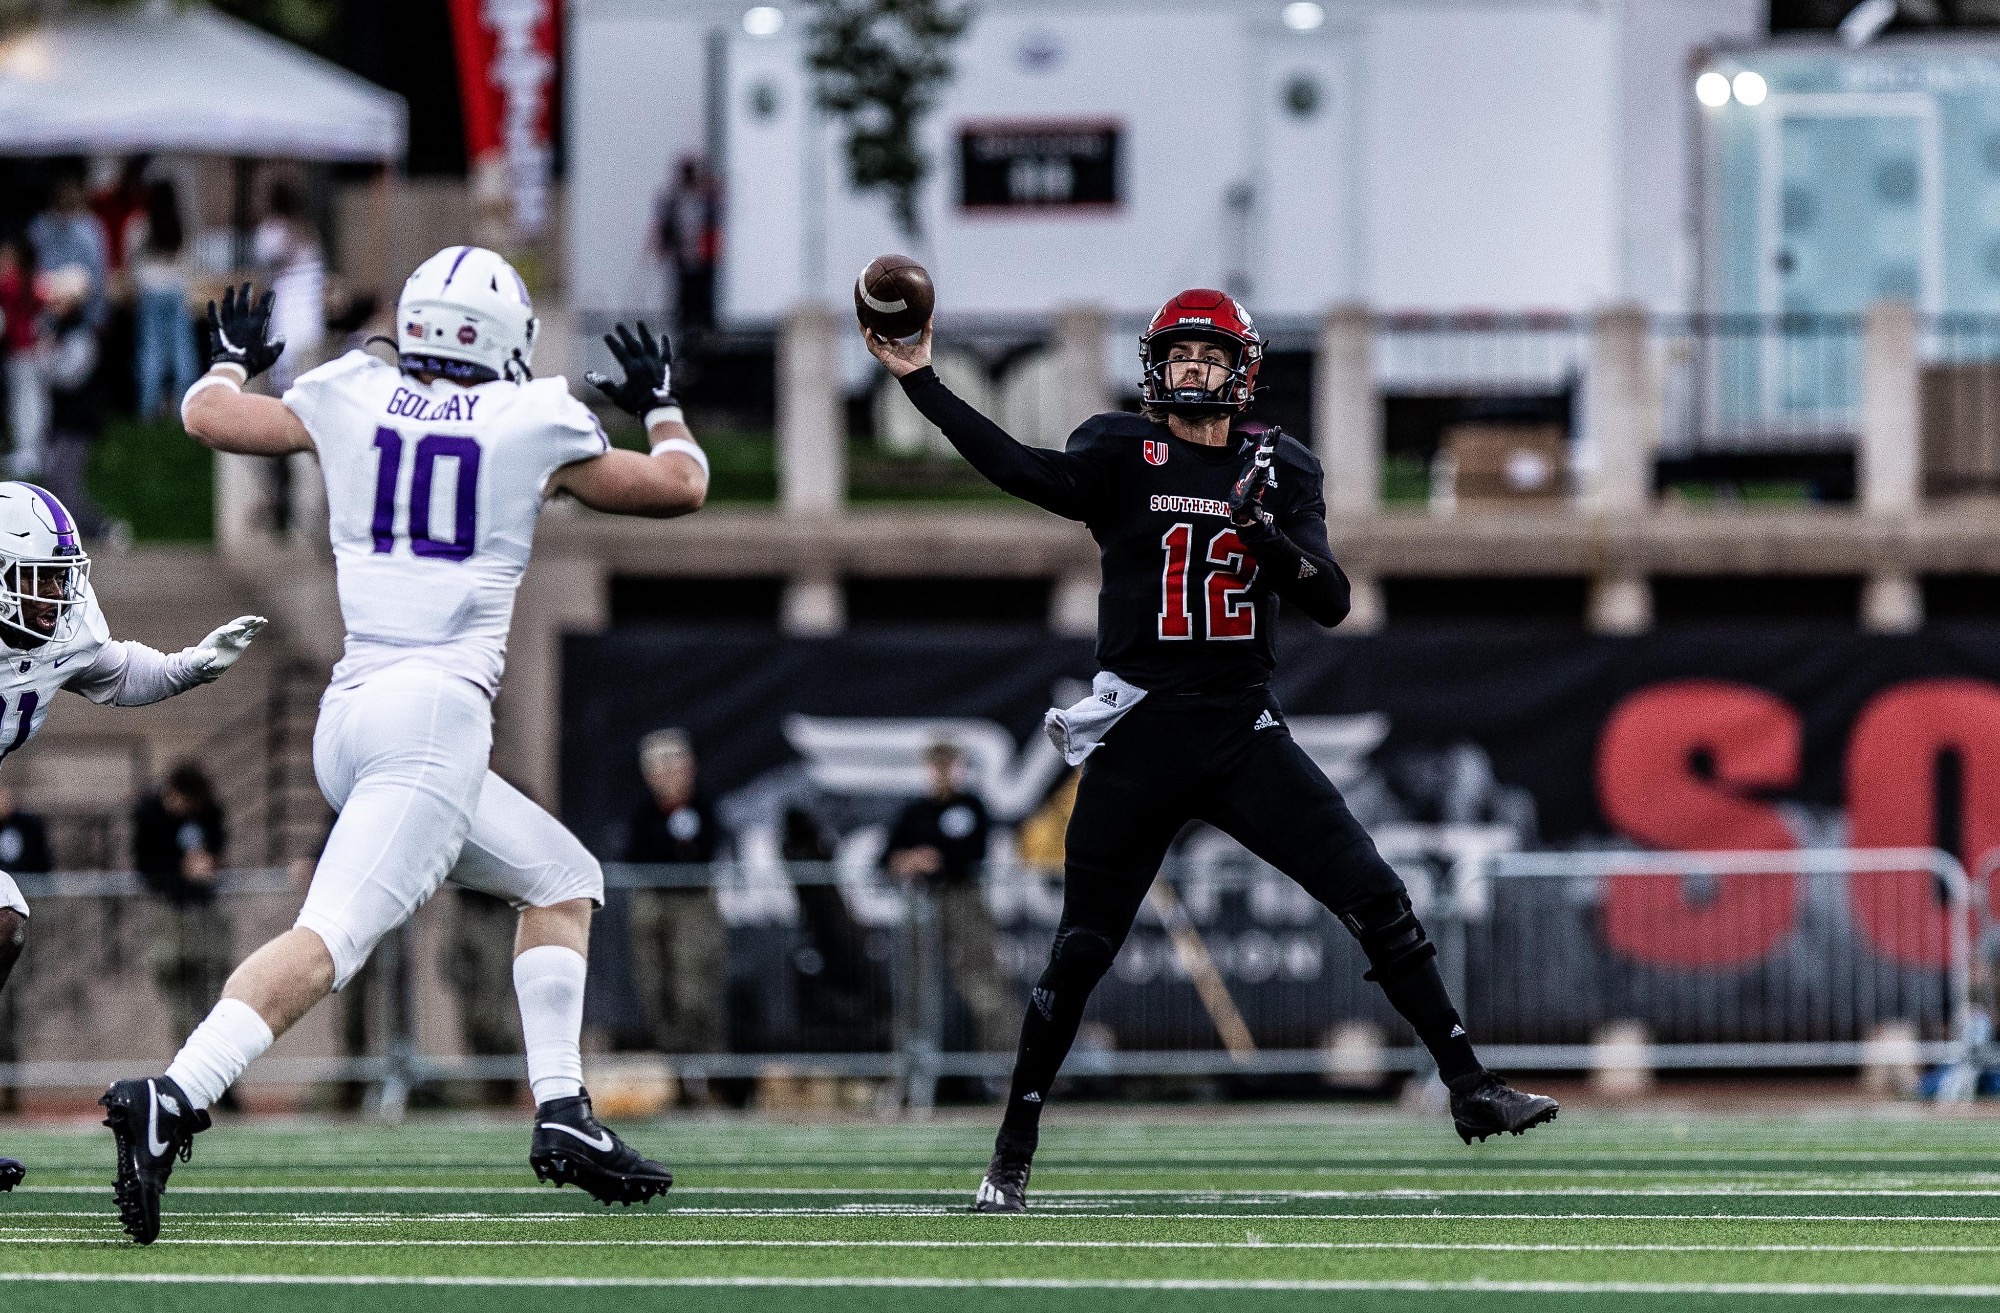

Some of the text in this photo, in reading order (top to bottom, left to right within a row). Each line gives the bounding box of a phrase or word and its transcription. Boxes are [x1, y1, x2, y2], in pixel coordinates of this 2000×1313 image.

[1178, 316, 1212, 325] Riddell
[387, 387, 480, 421] GOLDAY
[372, 425, 482, 562] 10
[1150, 495, 1231, 518] SOUTHERN
[1158, 522, 1260, 640] 12
[1254, 720, 1280, 730] adidas
